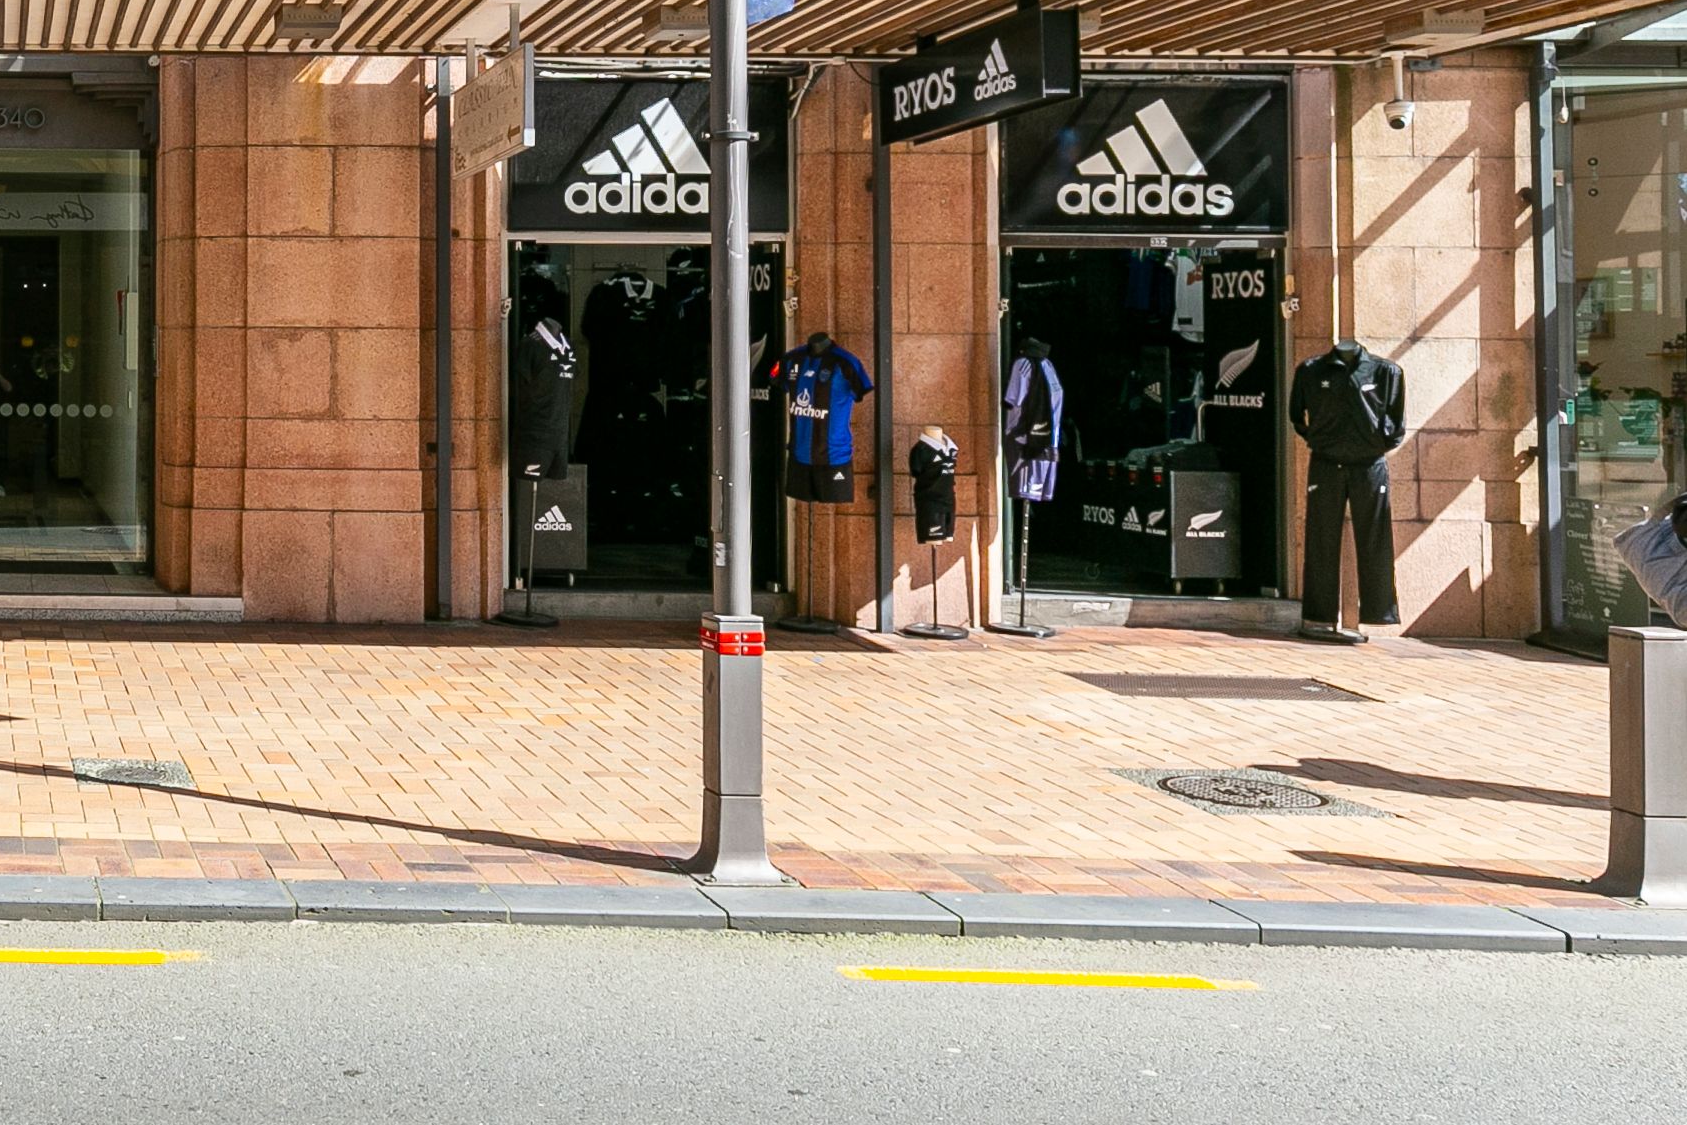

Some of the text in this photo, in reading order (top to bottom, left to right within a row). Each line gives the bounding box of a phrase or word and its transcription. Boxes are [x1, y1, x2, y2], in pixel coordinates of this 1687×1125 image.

[893, 66, 1017, 122] RYOS adidas
[564, 171, 710, 215] adida
[1056, 173, 1235, 217] adidas
[749, 263, 771, 292] OS
[1211, 269, 1265, 299] RYOS
[751, 388, 769, 401] LACKS
[1213, 394, 1263, 408] ALL BLACKS
[534, 521, 573, 532] adidas
[1083, 504, 1115, 525] RYOS
[1185, 530, 1226, 538] ALL BLACKS
